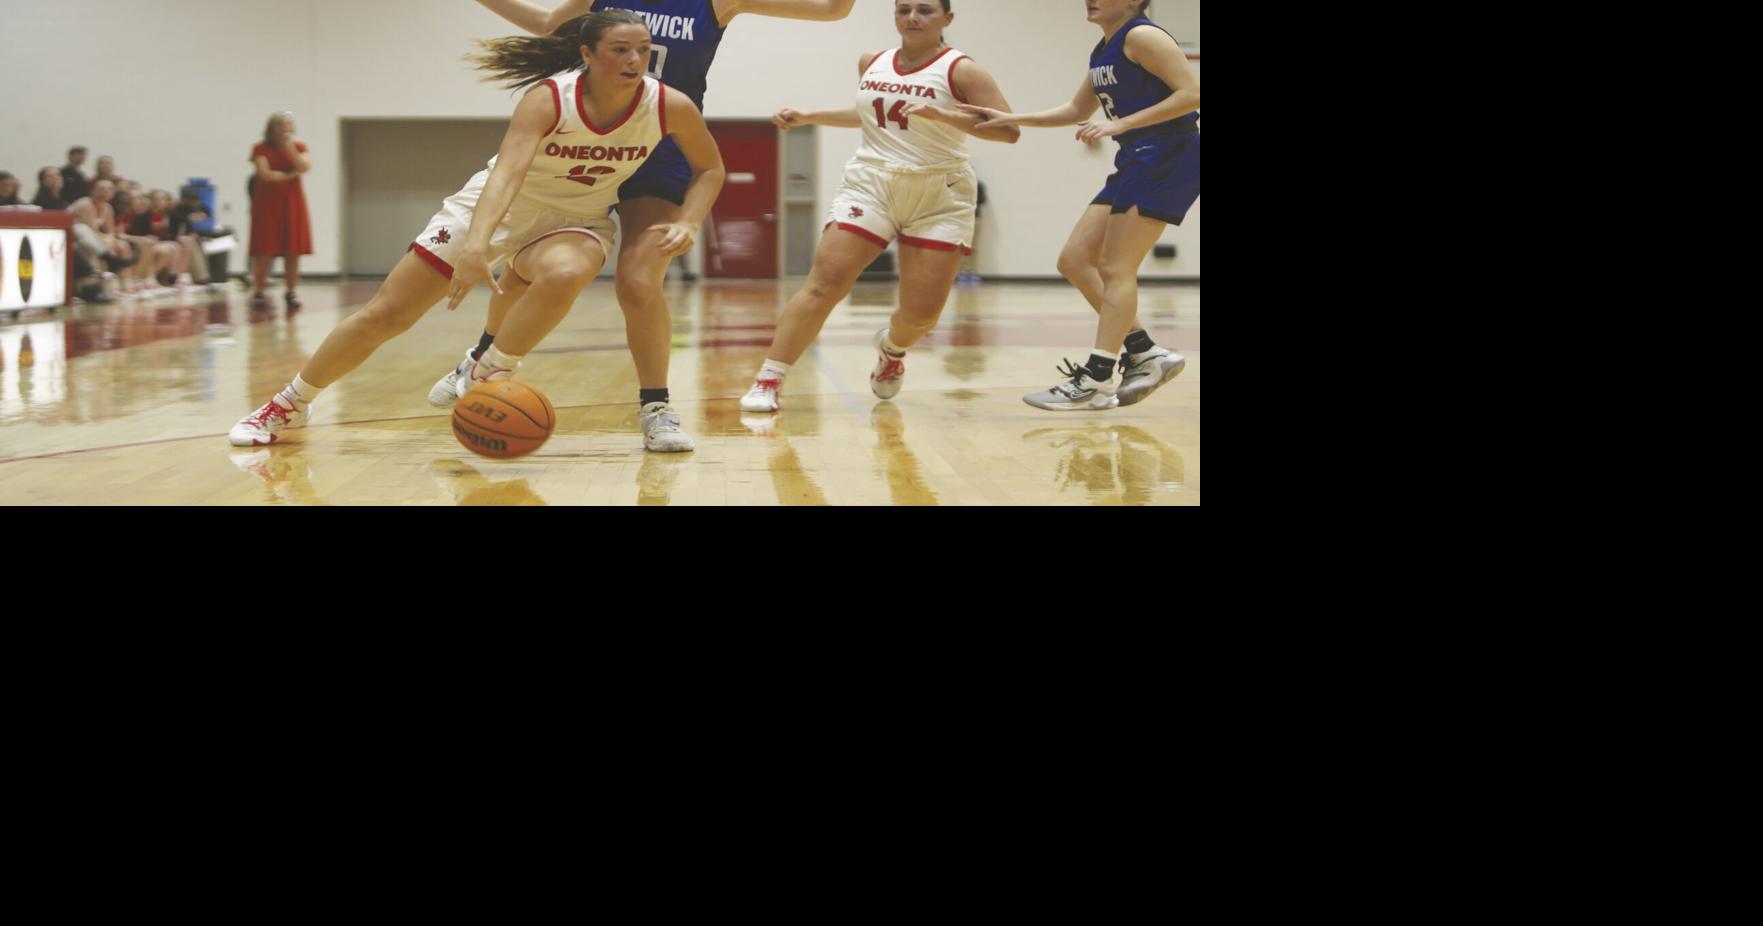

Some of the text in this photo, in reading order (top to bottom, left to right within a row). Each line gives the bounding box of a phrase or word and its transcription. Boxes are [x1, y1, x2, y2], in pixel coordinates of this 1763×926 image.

[860, 80, 937, 99] ONEONTA
[872, 97, 909, 130] 14
[545, 142, 648, 161] ONEONTA
